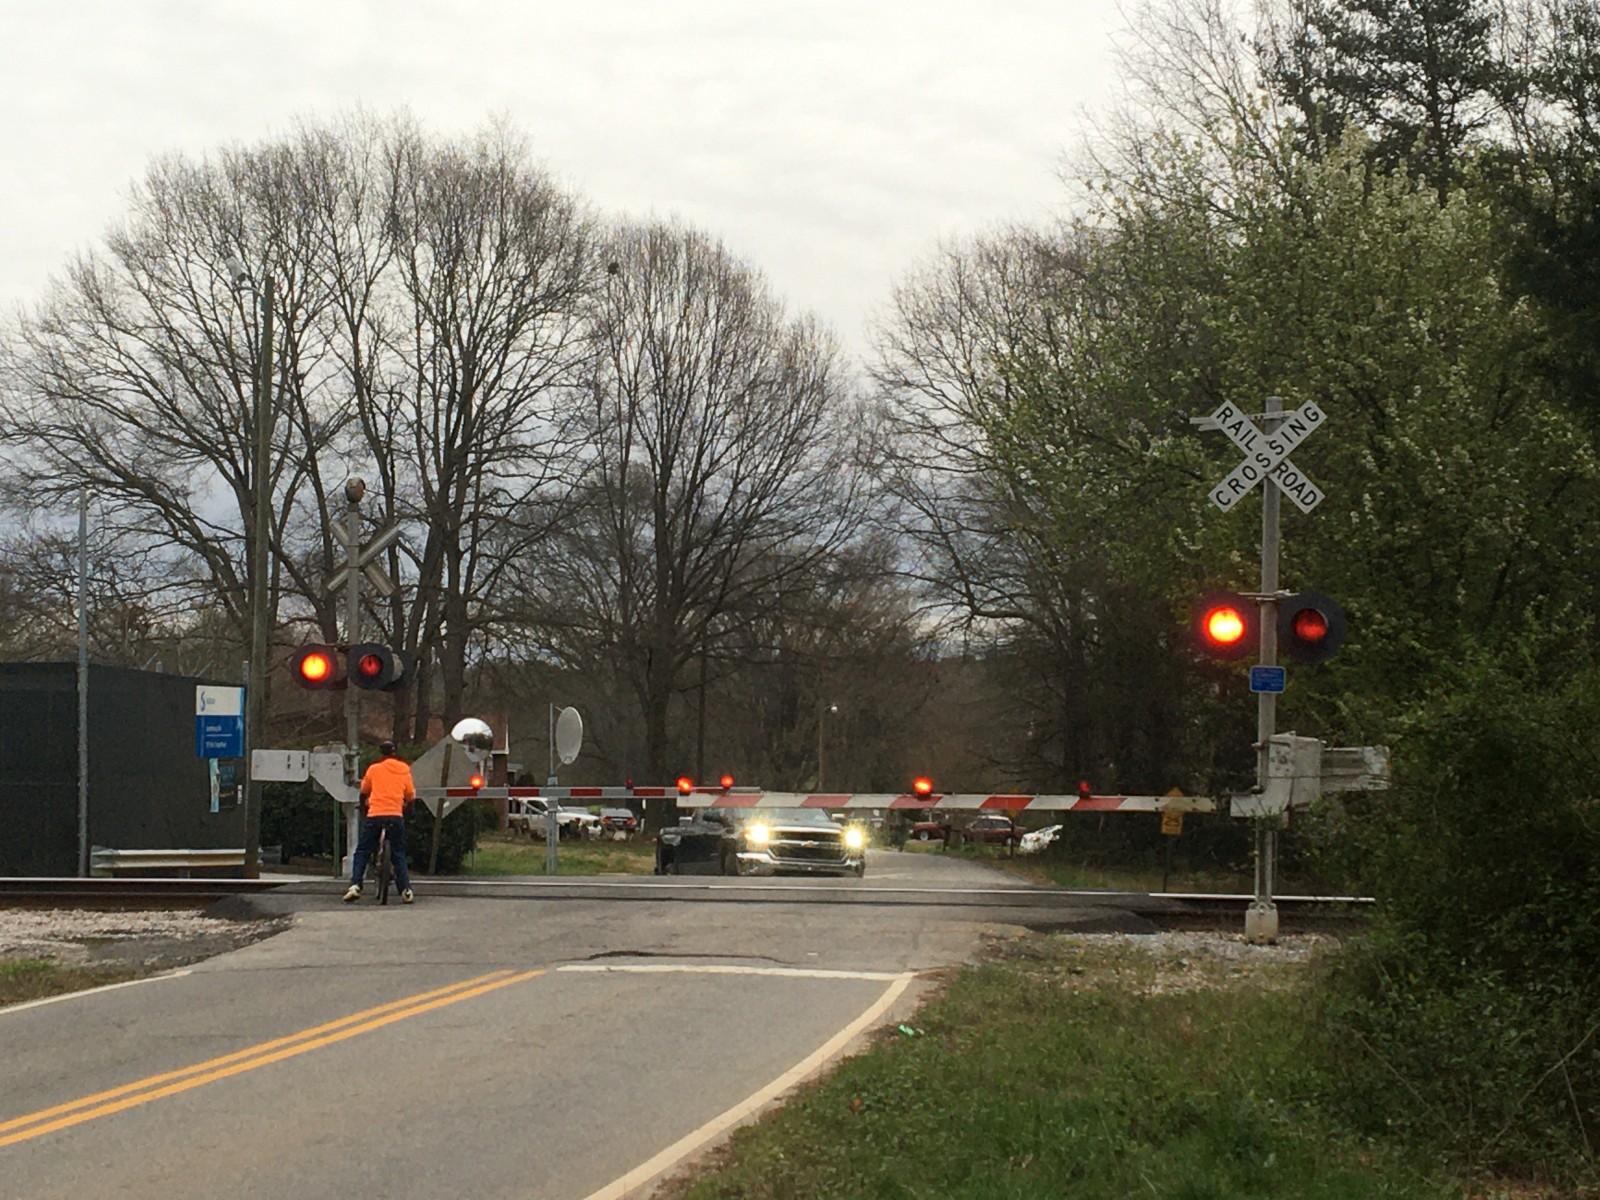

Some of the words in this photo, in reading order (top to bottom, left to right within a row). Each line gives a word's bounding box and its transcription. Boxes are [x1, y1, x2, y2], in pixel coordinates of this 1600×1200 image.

[1215, 406, 1320, 506] CROSSING
[1216, 406, 1258, 452] RAIL
[1272, 461, 1317, 506] ROAD
